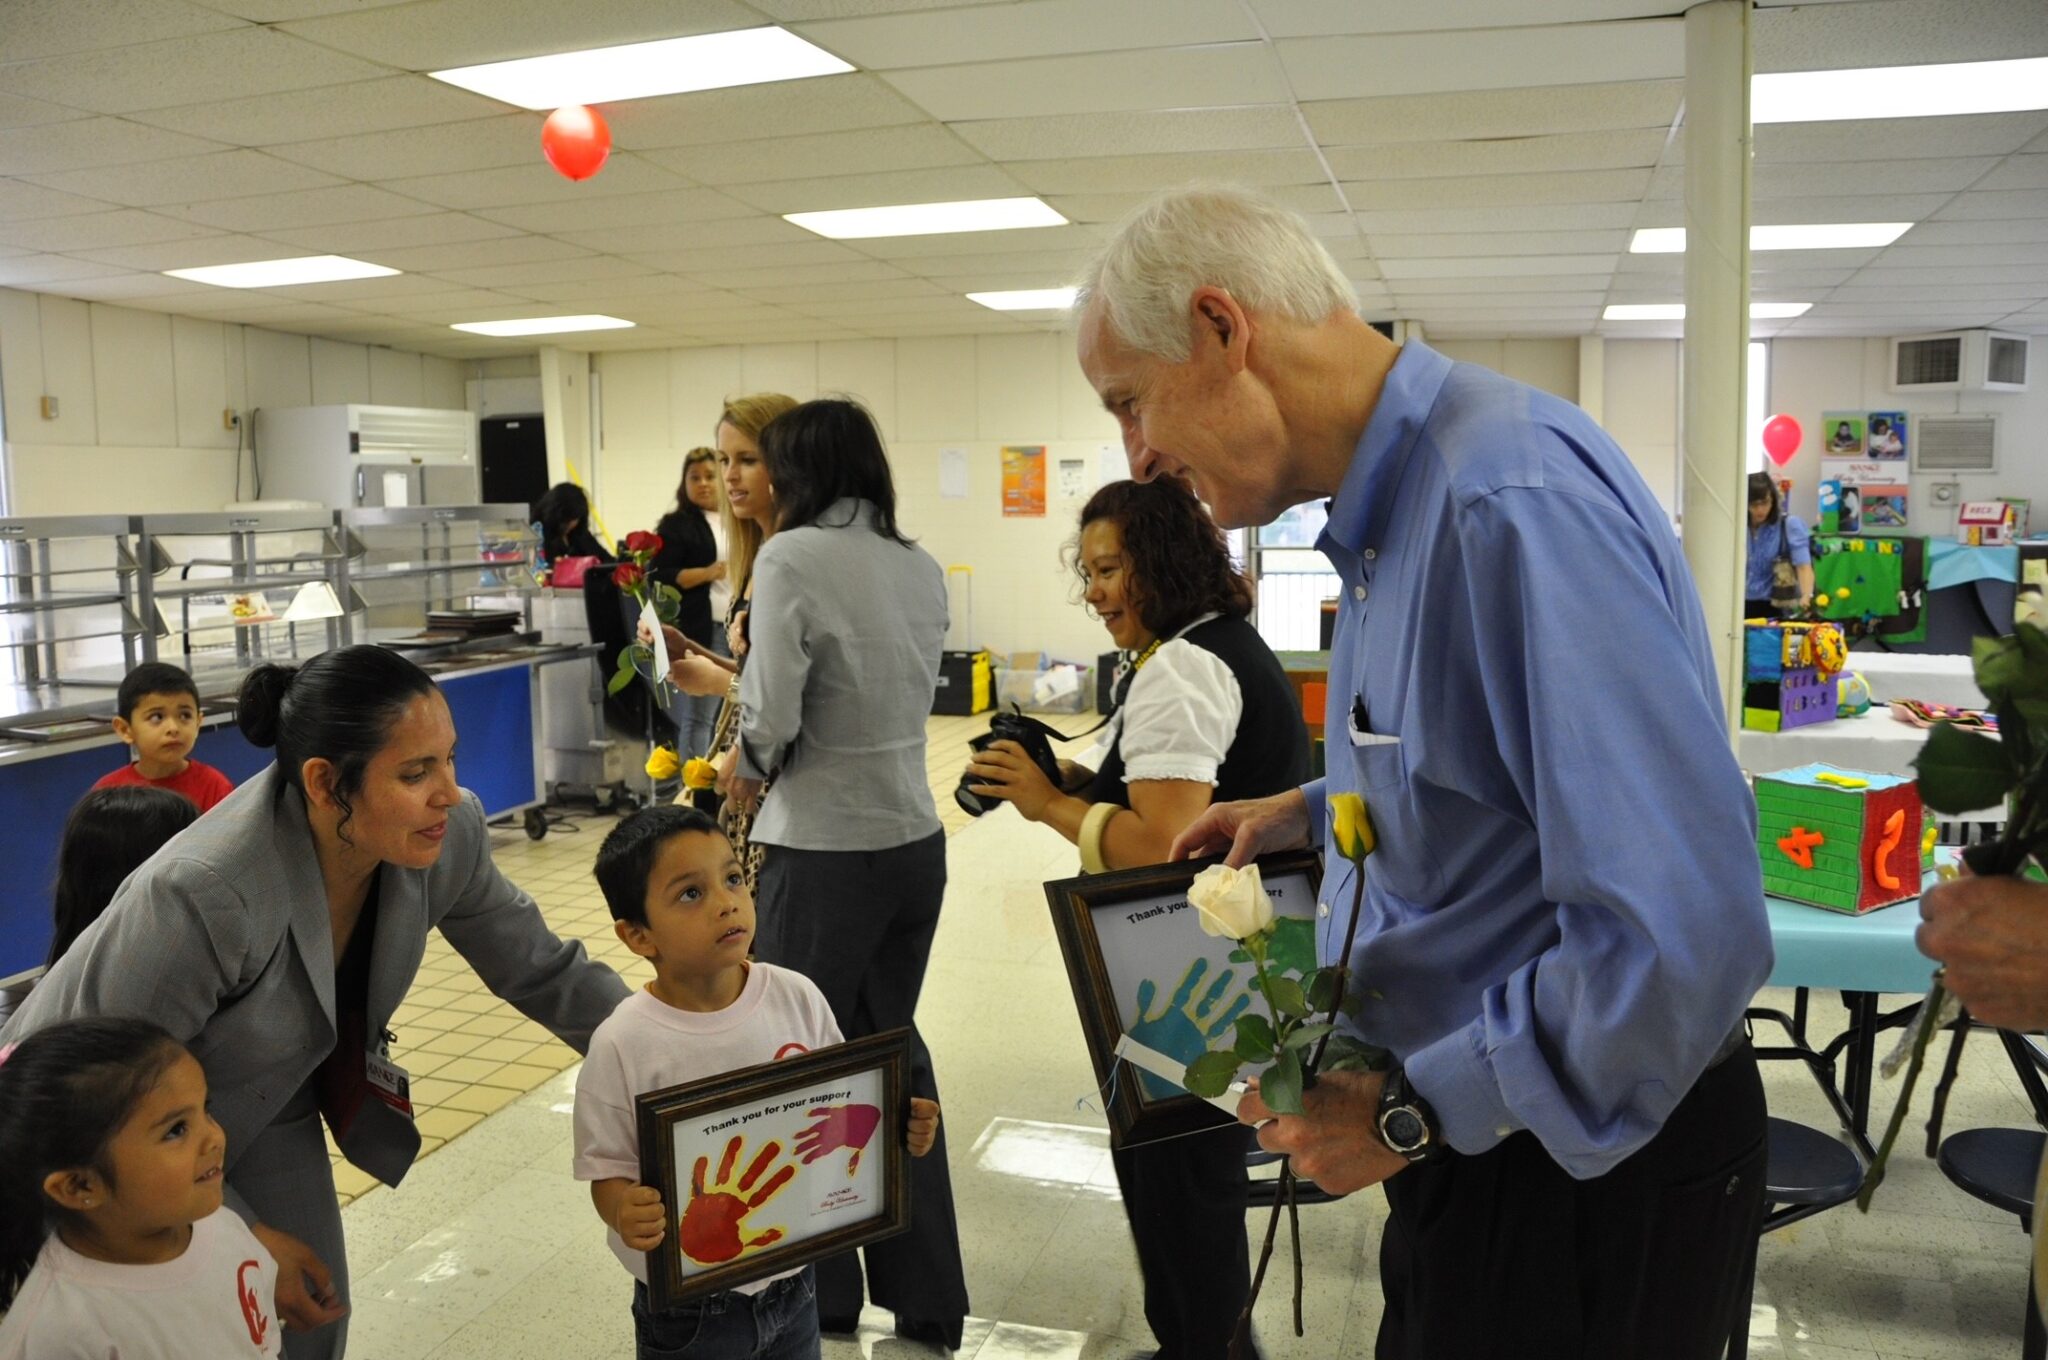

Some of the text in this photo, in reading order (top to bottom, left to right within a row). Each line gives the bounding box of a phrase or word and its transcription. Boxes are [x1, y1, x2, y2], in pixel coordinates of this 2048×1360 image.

[1126, 901, 1188, 924] Thank you
[702, 1091, 851, 1136] Thank you for your support
